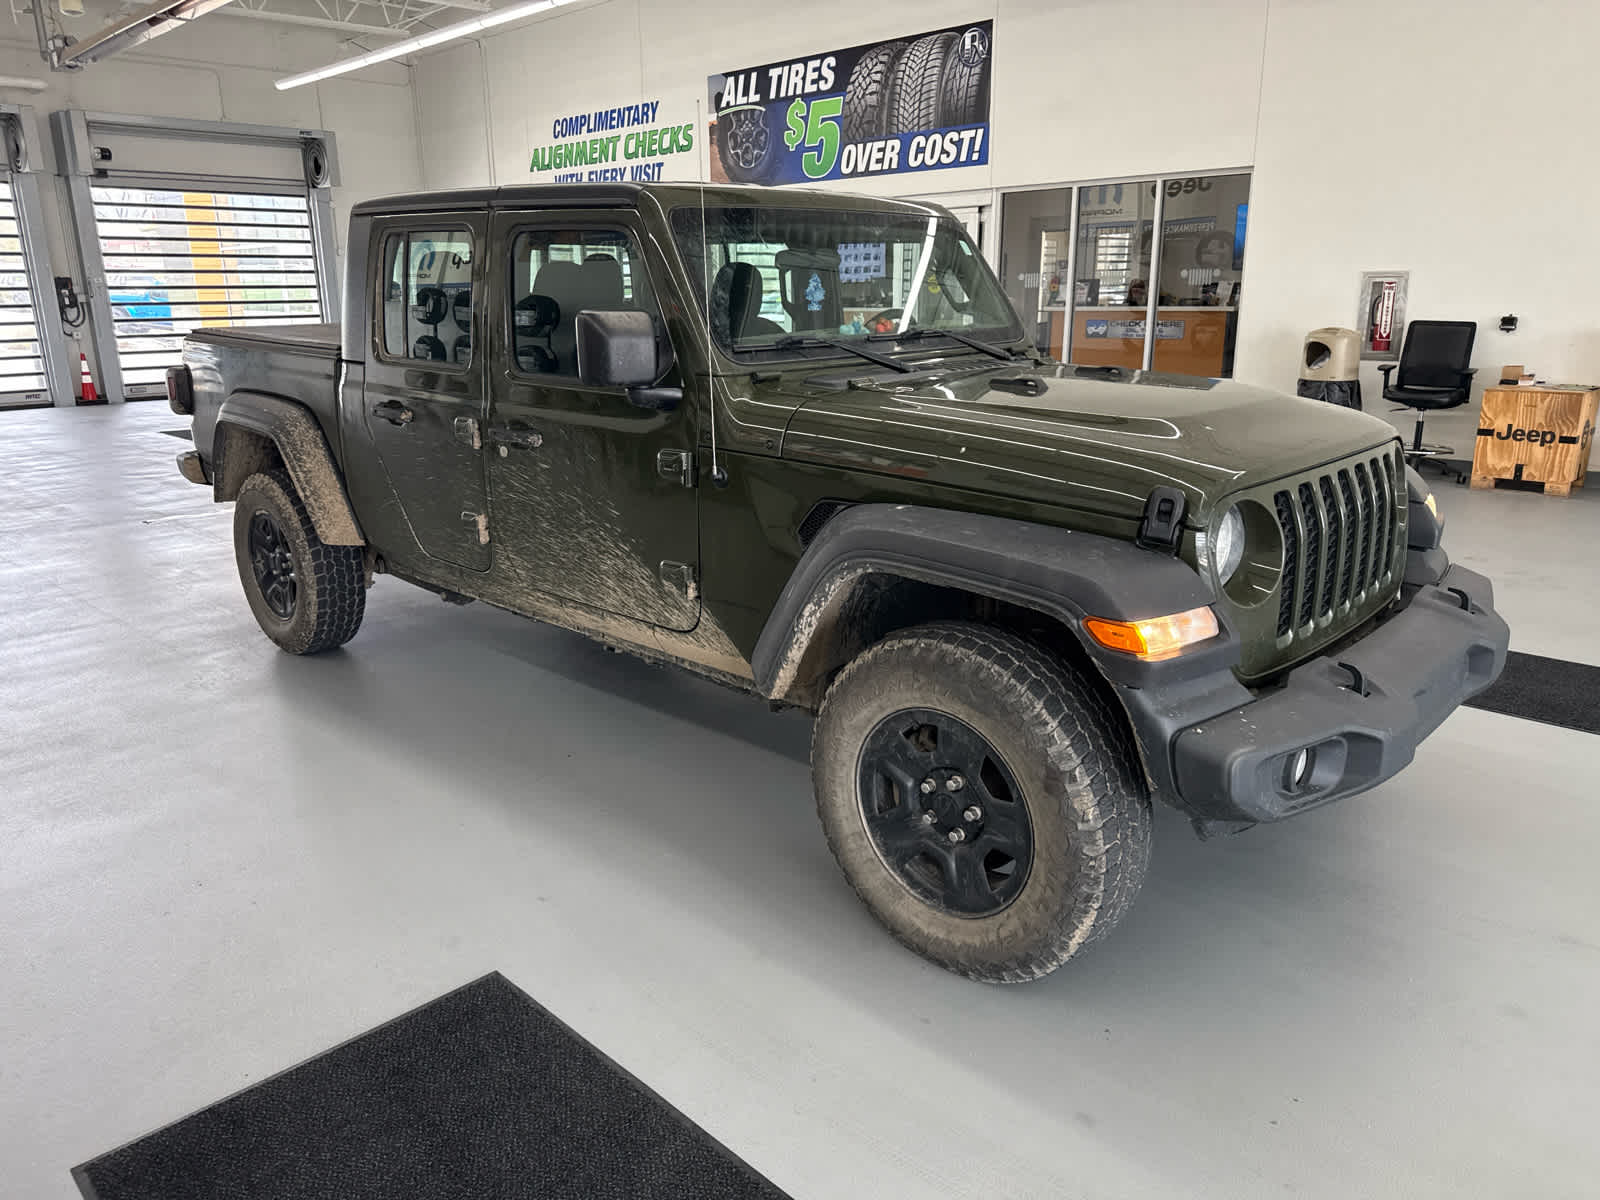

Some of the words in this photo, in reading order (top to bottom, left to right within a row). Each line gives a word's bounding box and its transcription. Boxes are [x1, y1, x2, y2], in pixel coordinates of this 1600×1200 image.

[720, 71, 760, 108] ALL
[768, 56, 836, 100] TIRES
[553, 100, 659, 139] COMPLIMENTARY
[784, 96, 844, 179] $5
[530, 134, 621, 172] ALIGNMENT
[623, 123, 694, 160] CHECKS
[840, 139, 901, 175] OVER
[908, 128, 984, 168] COST!
[631, 162, 664, 182] VISIT
[1496, 424, 1556, 447] Jeep
